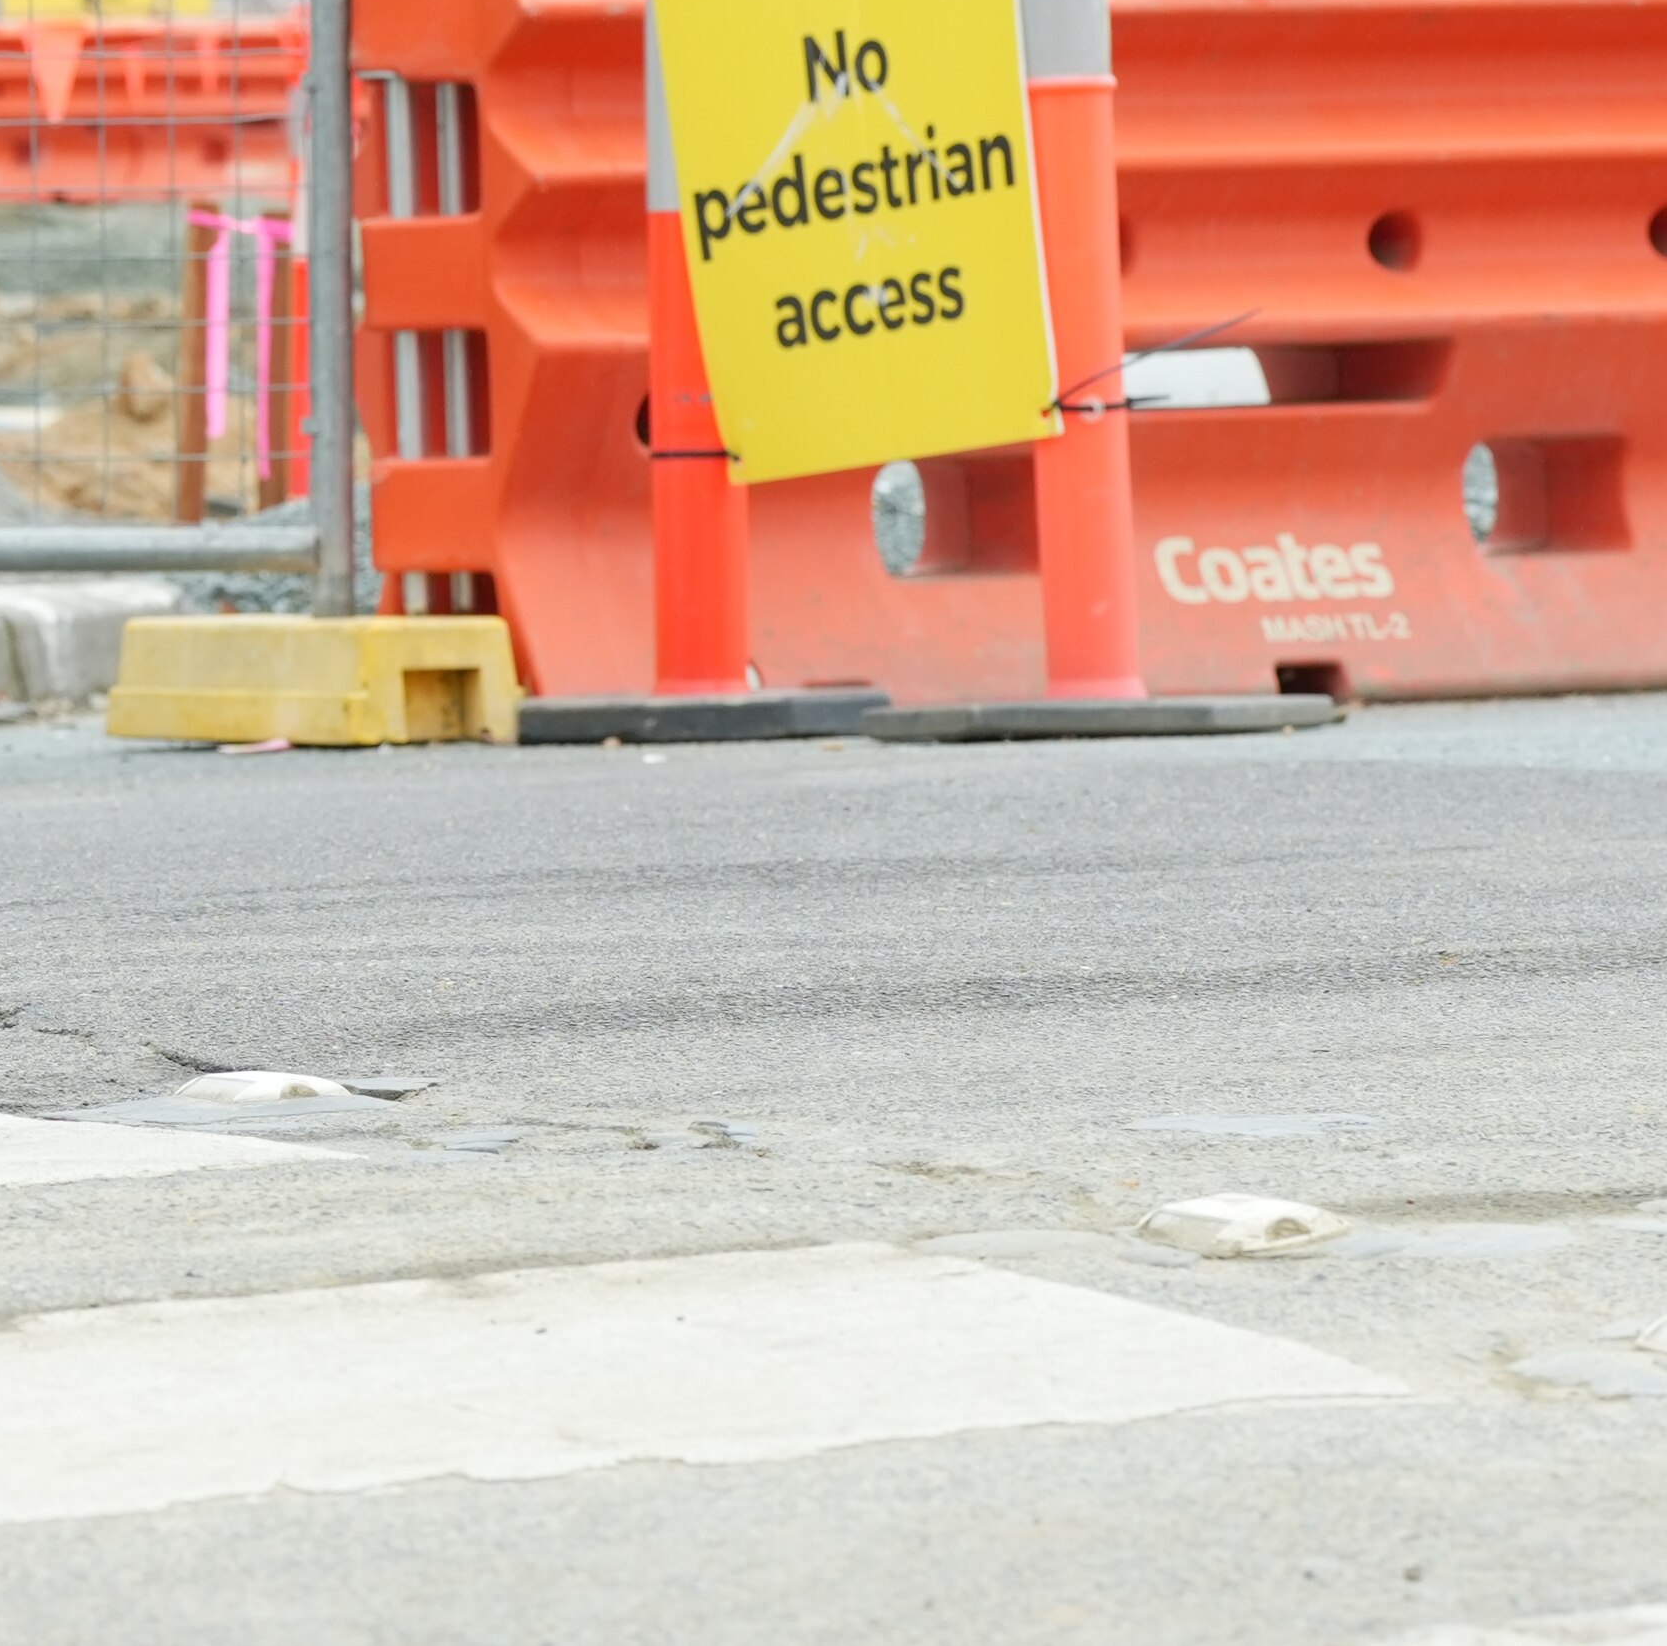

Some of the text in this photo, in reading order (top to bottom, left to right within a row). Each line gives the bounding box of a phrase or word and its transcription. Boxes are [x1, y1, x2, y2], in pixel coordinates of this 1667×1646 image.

[802, 29, 888, 103] No
[693, 124, 1015, 261] pedestrian
[774, 266, 966, 349] access
[1153, 531, 1395, 604] Coates
